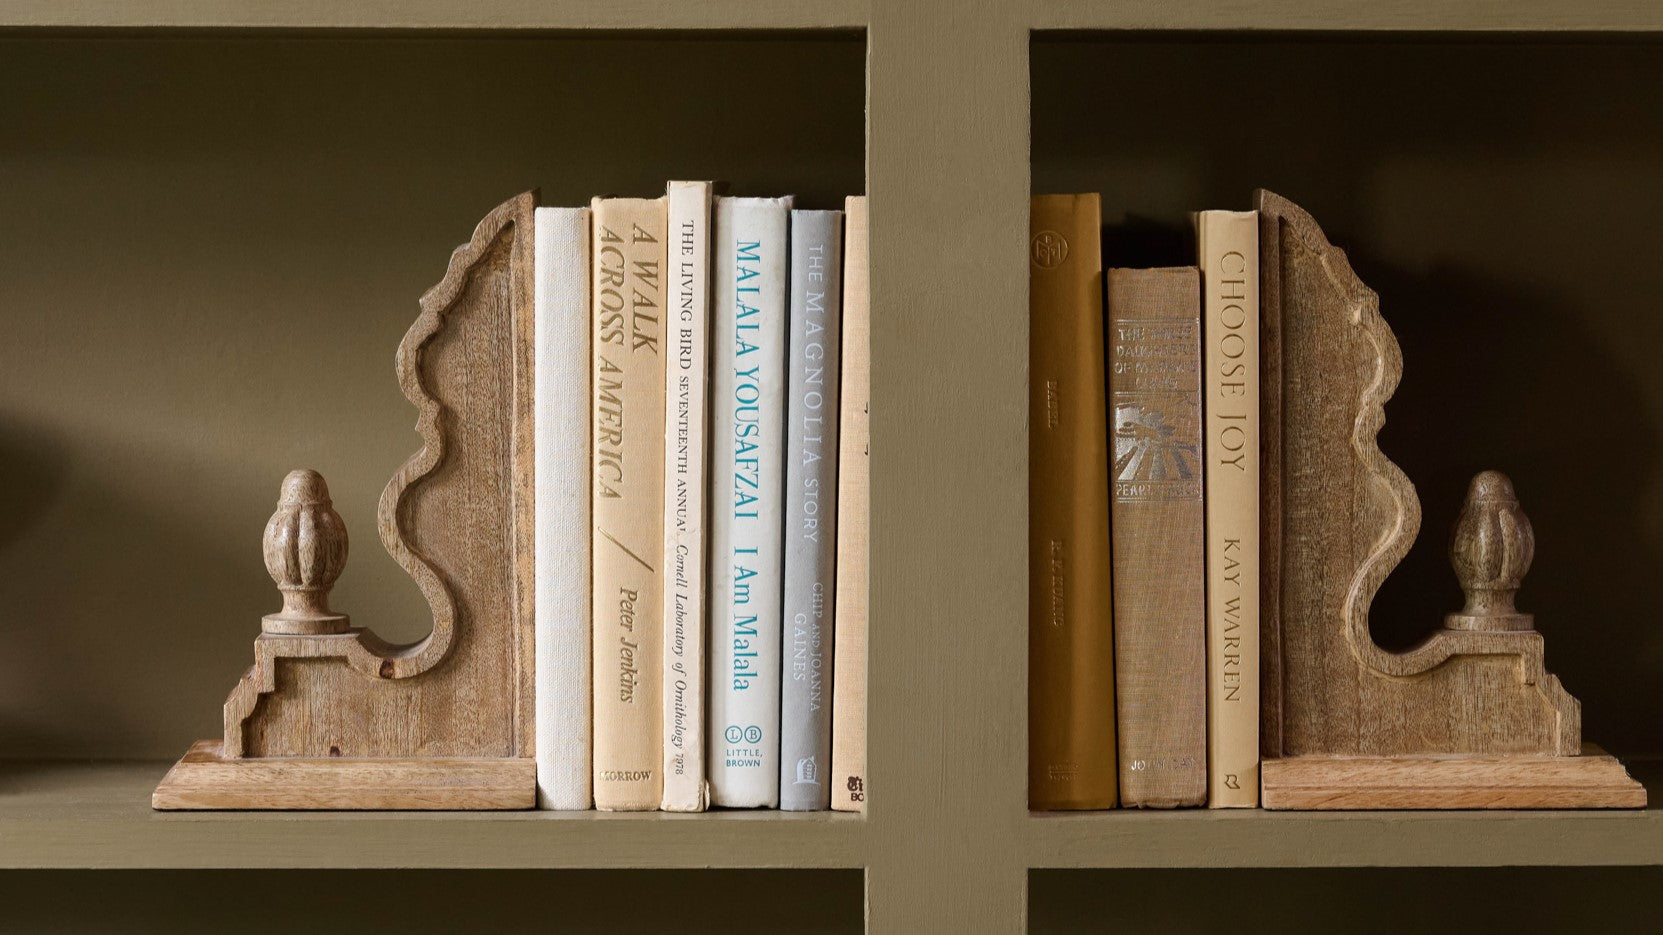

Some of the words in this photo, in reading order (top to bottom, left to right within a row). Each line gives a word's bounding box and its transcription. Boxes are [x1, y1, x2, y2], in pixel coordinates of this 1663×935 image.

[632, 222, 659, 245] A
[681, 220, 694, 256] THE
[808, 244, 824, 282] THE
[599, 225, 625, 347] ACROSS
[632, 259, 659, 354] WALK
[680, 261, 693, 322] LIVING
[735, 239, 761, 358] MALALA
[679, 329, 692, 370] BIRD
[1219, 250, 1246, 397] CHOOSE
[802, 290, 825, 466] MAGNOLIA
[597, 355, 623, 499] AMERICA
[677, 375, 689, 474] SEVENTEENTH
[733, 365, 760, 520] YOUSAFZAI
[1216, 413, 1247, 471] JOY
[803, 478, 818, 543] STORY
[675, 544, 689, 588] Cornell
[733, 545, 759, 556] I
[1223, 538, 1241, 587] KAY
[619, 586, 638, 633] Peter
[733, 566, 759, 605] Am
[812, 582, 824, 618] CHIP
[671, 593, 688, 657] Laboratory
[733, 613, 759, 692] Malala
[793, 613, 807, 681] GAINES
[810, 623, 820, 648] AND
[1223, 597, 1241, 702] WARREN
[619, 636, 639, 704] Jenkins
[671, 662, 687, 677] of
[810, 651, 822, 712] JOANNA
[671, 680, 687, 749] Ornithology
[726, 749, 763, 758] LITTLE,
